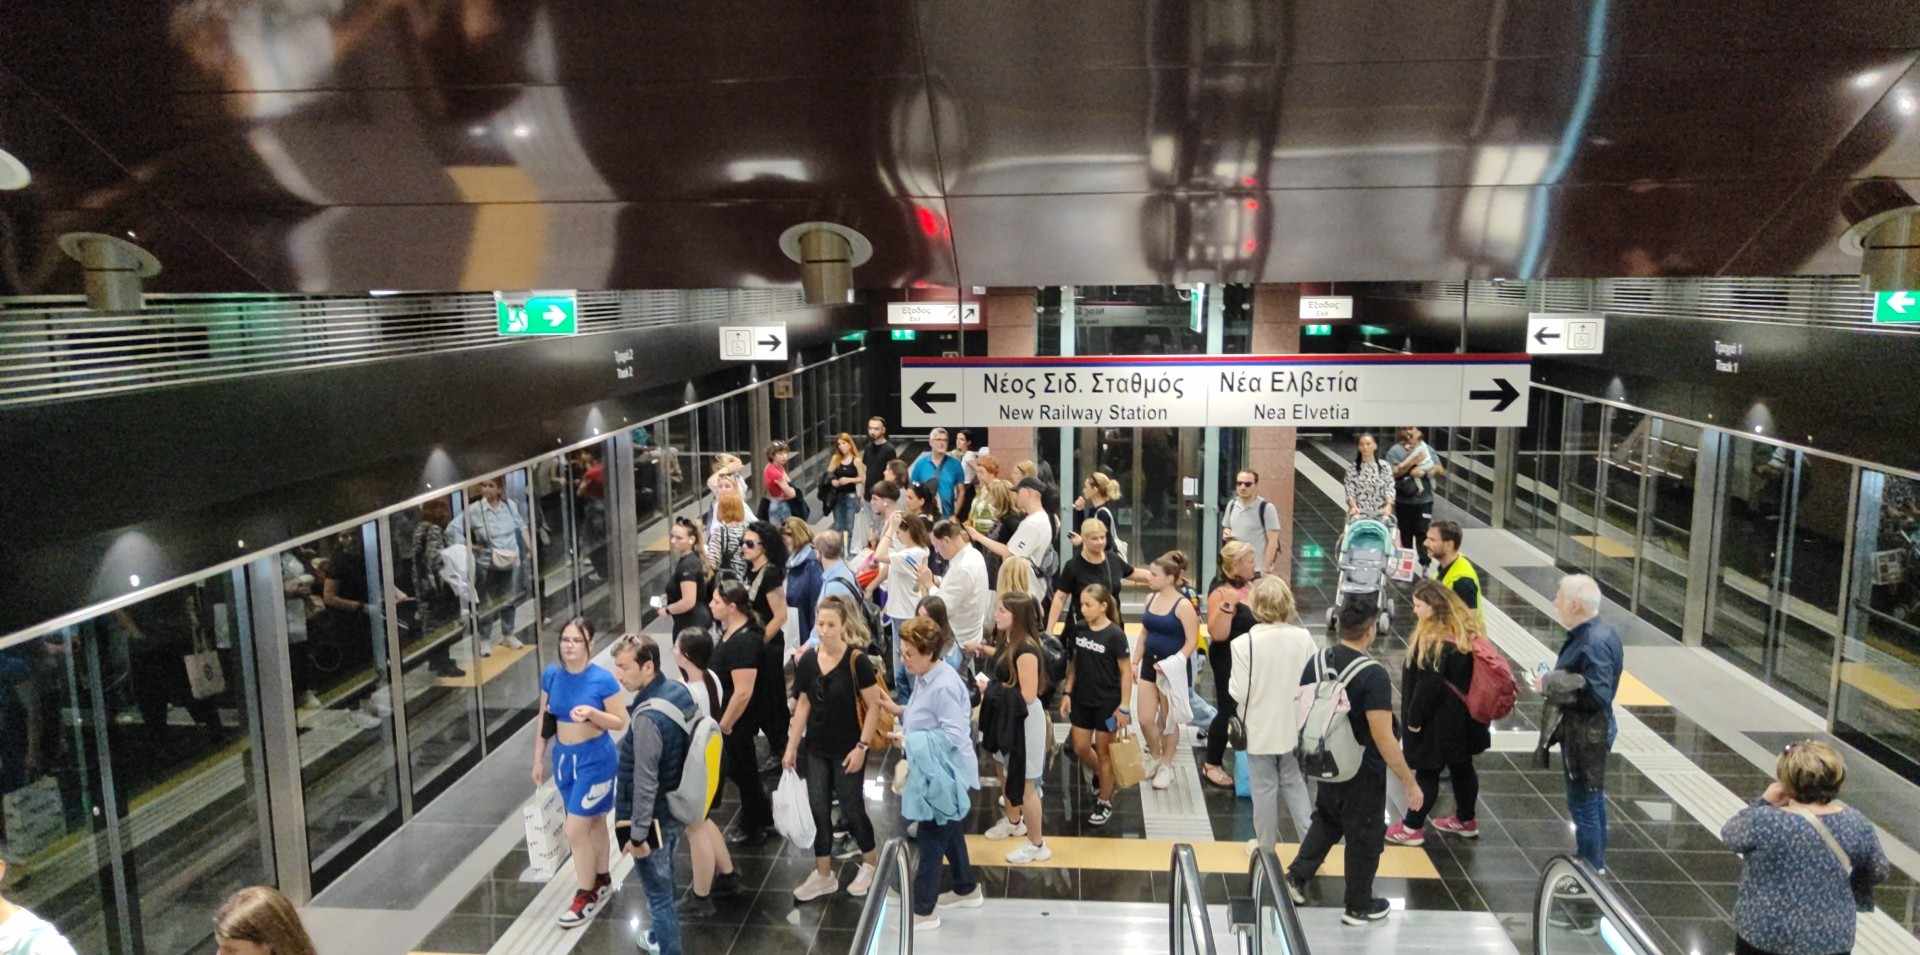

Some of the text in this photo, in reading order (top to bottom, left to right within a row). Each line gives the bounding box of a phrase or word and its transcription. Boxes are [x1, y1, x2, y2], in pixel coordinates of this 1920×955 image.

[984, 371, 1184, 399] Νέος Σιδ. Σταθμός
[1220, 370, 1358, 397] Νέα Ελβετία
[1000, 404, 1168, 424] New Railway Station
[1254, 403, 1350, 420] Nea Elvetia
[1075, 636, 1106, 653] adidas
